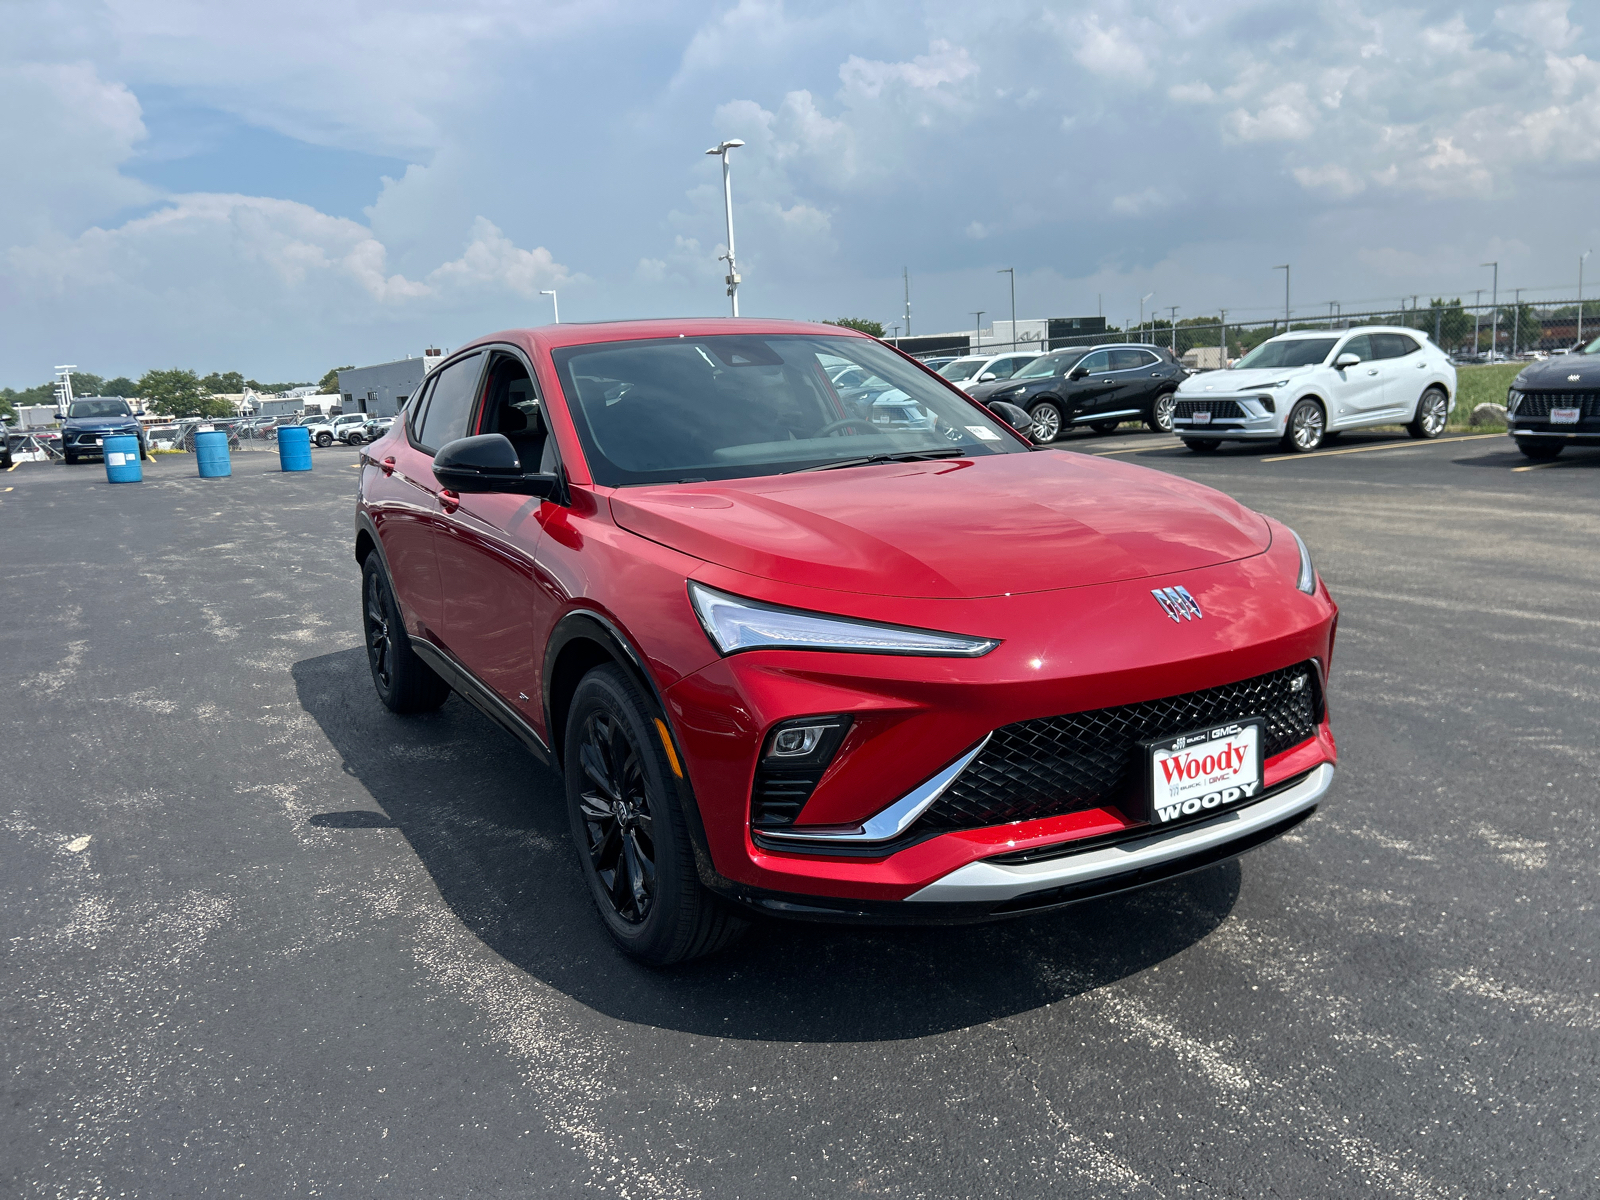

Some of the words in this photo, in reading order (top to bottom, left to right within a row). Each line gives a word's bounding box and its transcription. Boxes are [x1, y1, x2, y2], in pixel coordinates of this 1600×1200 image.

[1186, 734, 1206, 744] BUICK
[1211, 724, 1238, 739] GMC
[1159, 742, 1249, 785] Woody
[1180, 781, 1202, 791] BUICK
[1208, 773, 1230, 785] GMC
[1157, 779, 1260, 823] WOODY
